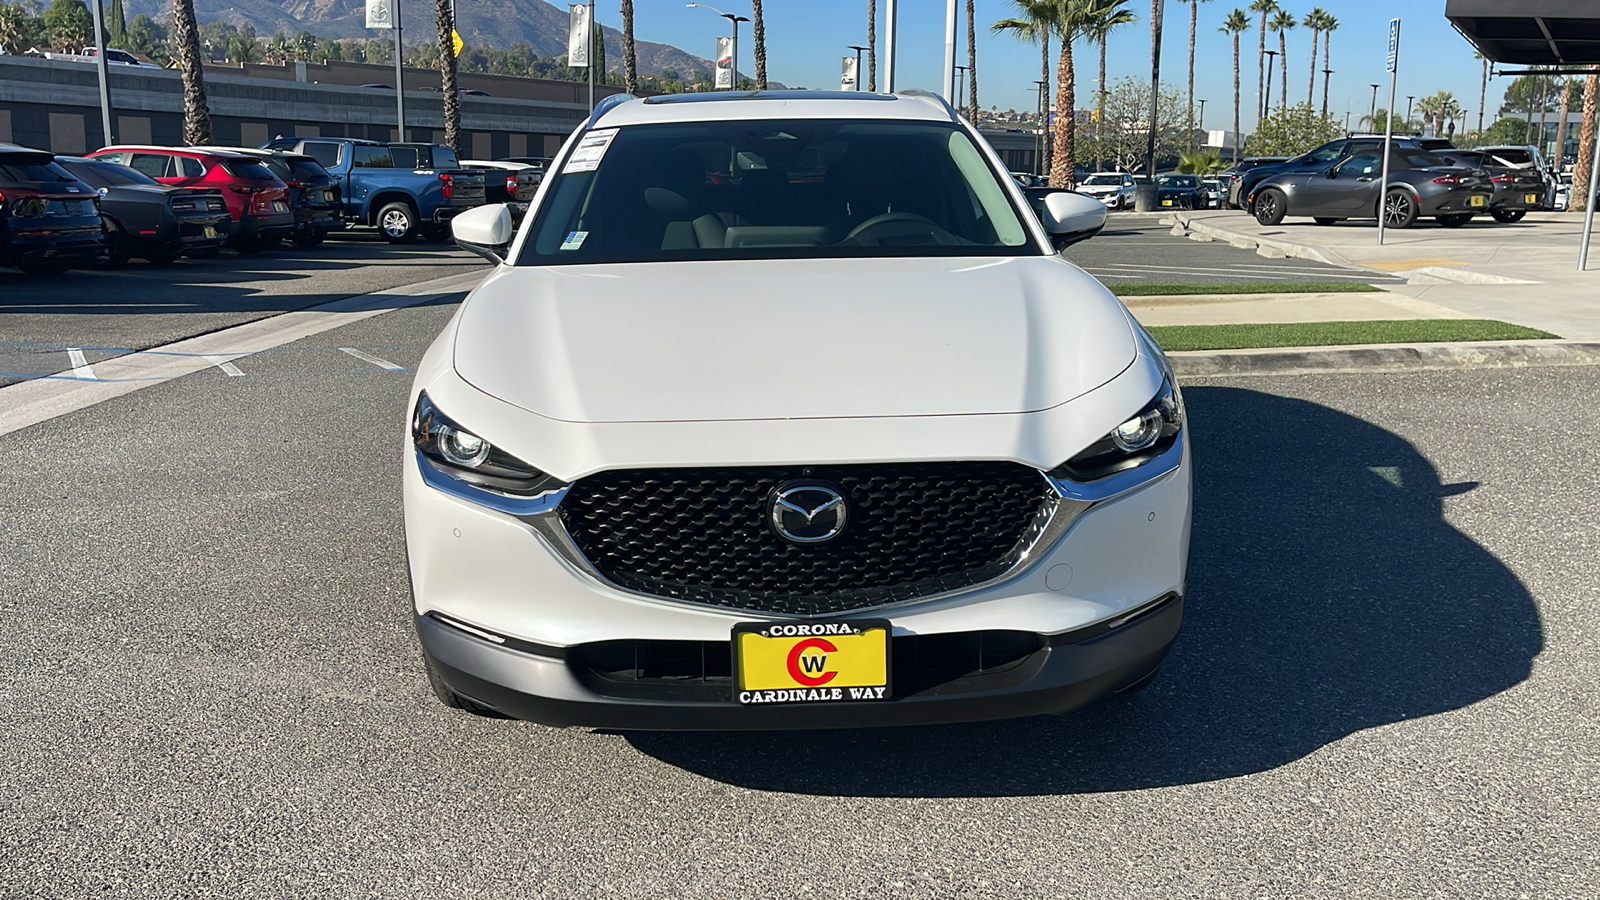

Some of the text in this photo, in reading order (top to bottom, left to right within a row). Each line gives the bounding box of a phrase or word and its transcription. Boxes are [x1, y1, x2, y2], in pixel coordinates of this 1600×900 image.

[770, 623, 853, 636] CORONA
[739, 686, 887, 704] CARDINALE WAY
